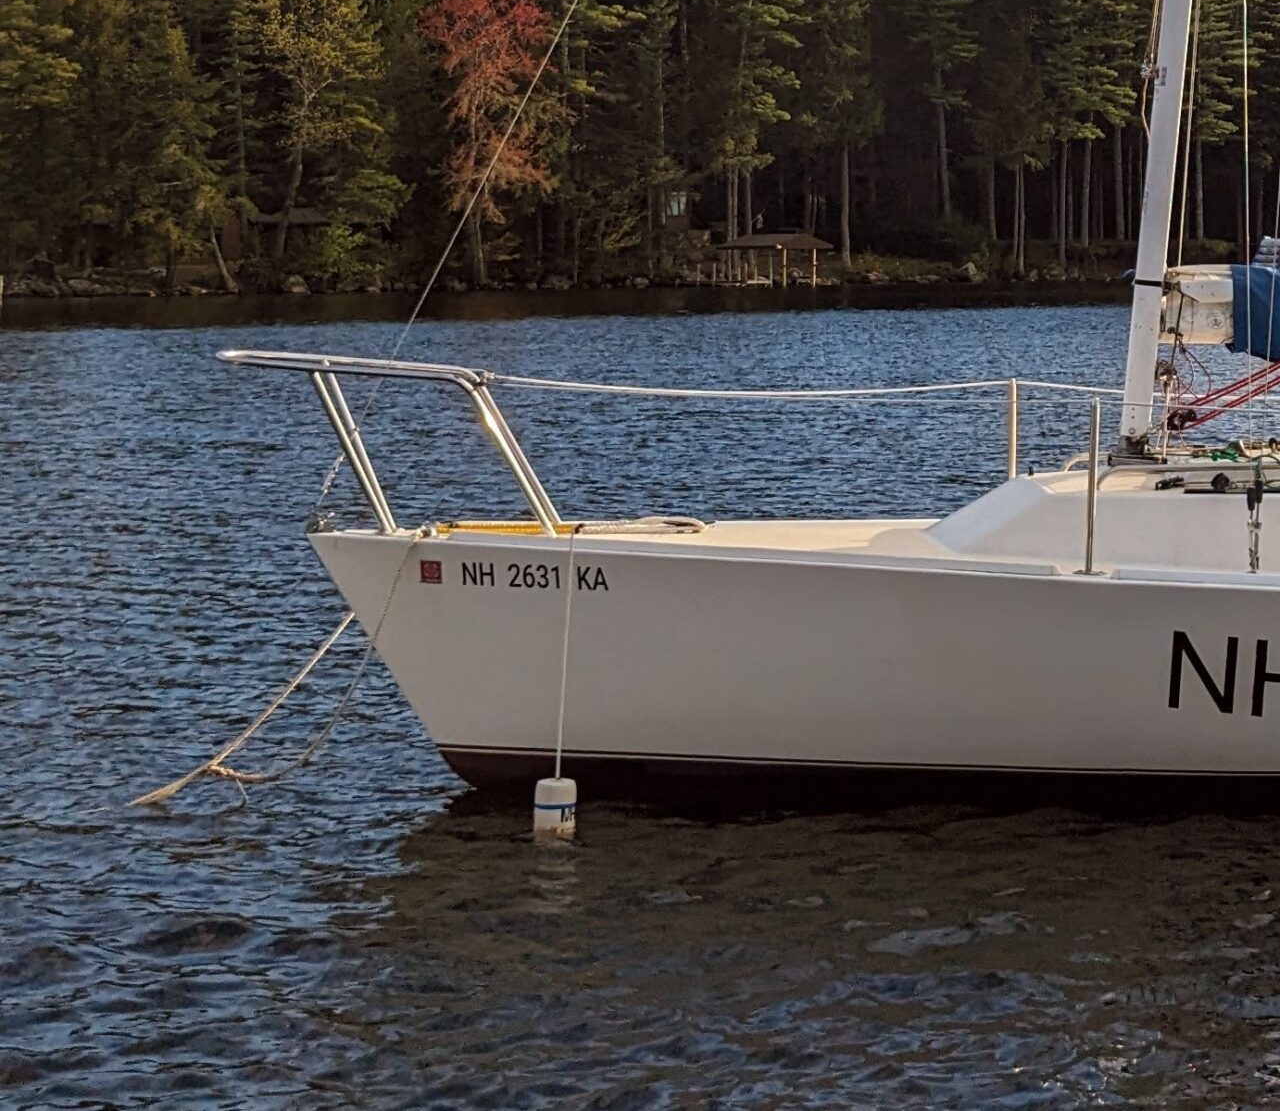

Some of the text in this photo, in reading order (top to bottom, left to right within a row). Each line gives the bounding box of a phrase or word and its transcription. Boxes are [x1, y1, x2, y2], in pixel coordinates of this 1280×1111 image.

[461, 561, 610, 591] NH 2631 KA
